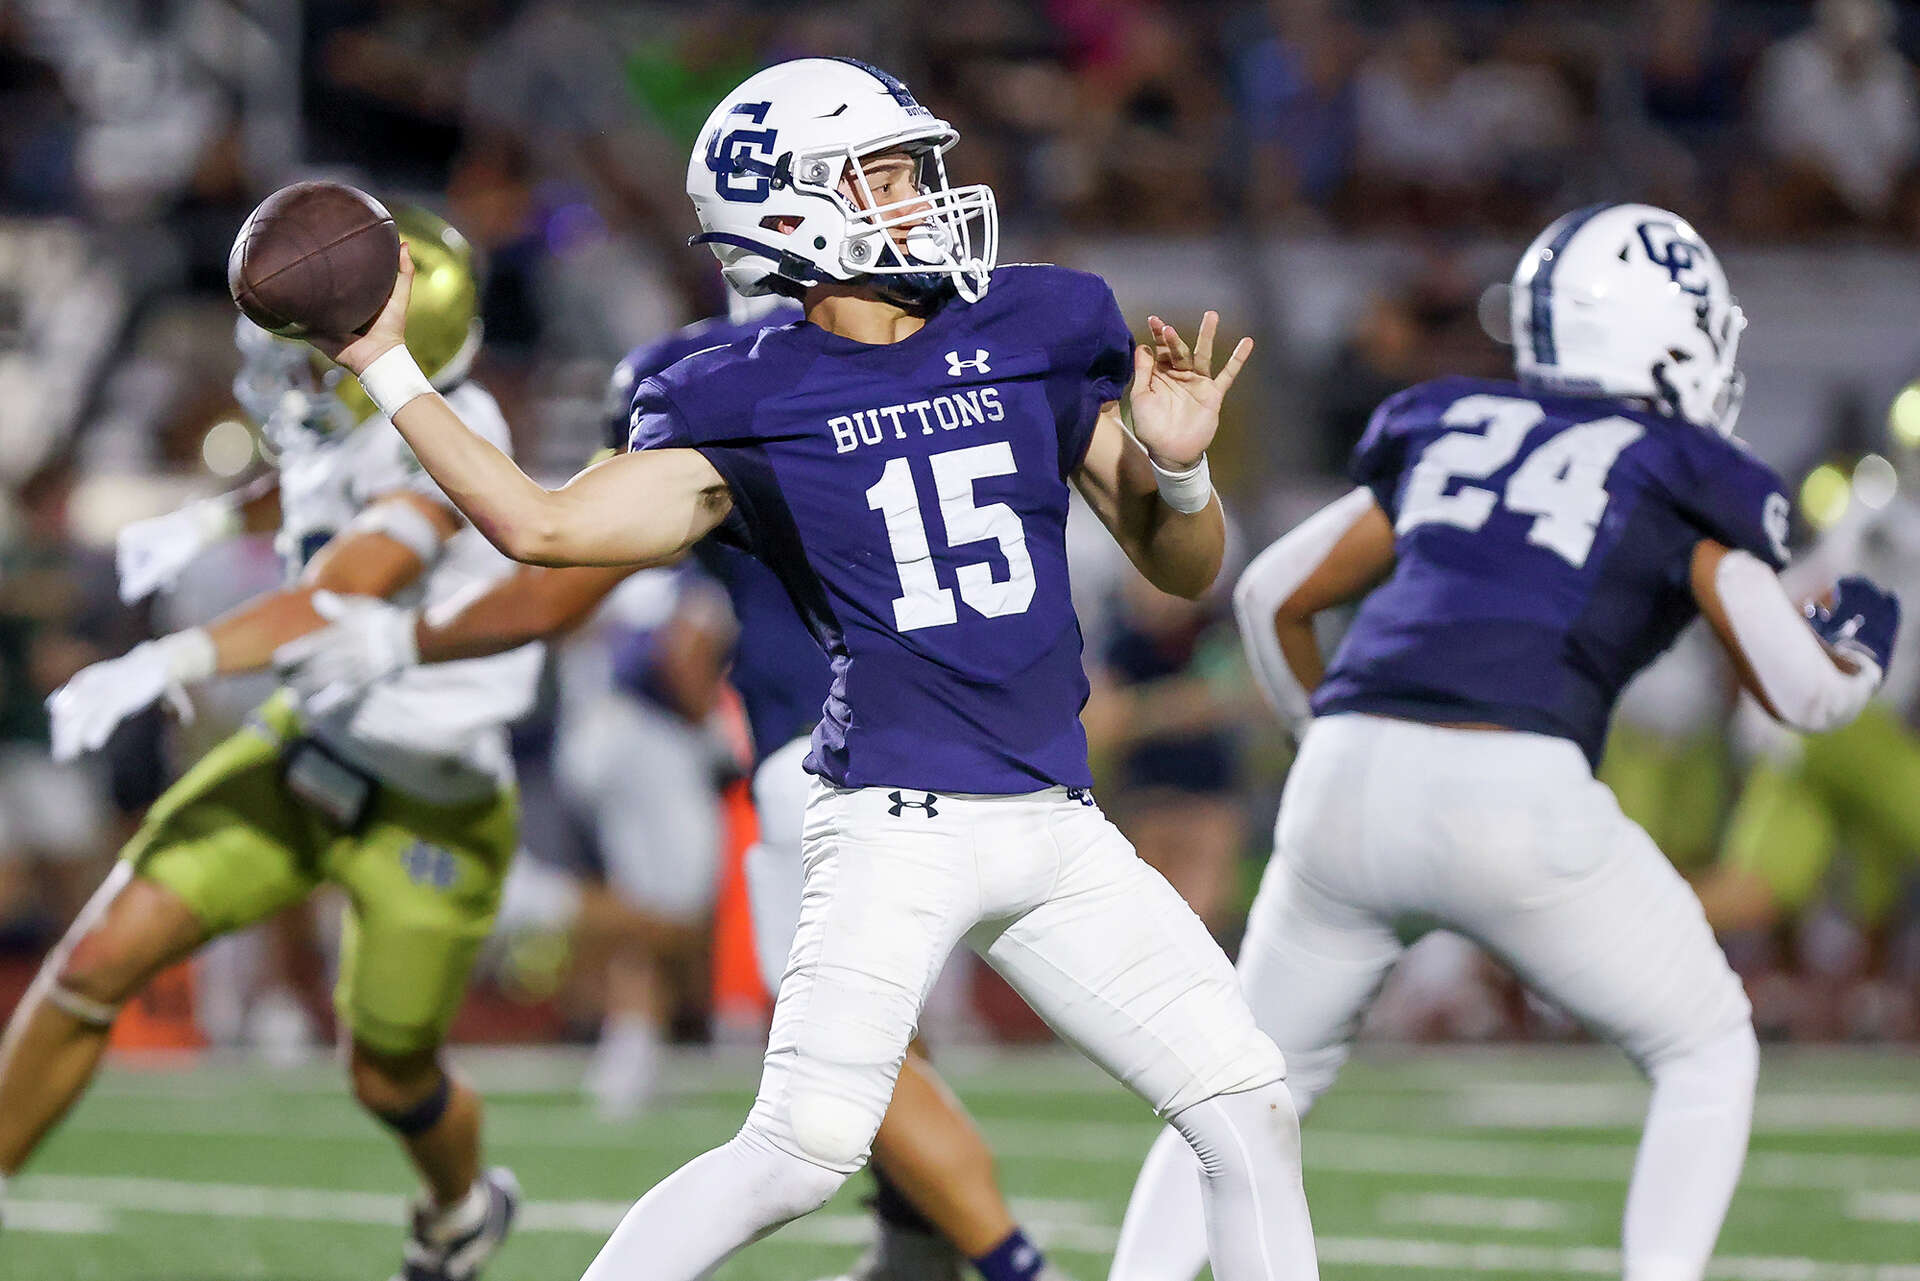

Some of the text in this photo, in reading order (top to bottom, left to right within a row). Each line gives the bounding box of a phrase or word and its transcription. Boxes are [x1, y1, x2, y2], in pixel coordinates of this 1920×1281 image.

[827, 387, 1005, 454] BUTTONS
[1395, 394, 1646, 569] 24
[865, 441, 1037, 632] 15
